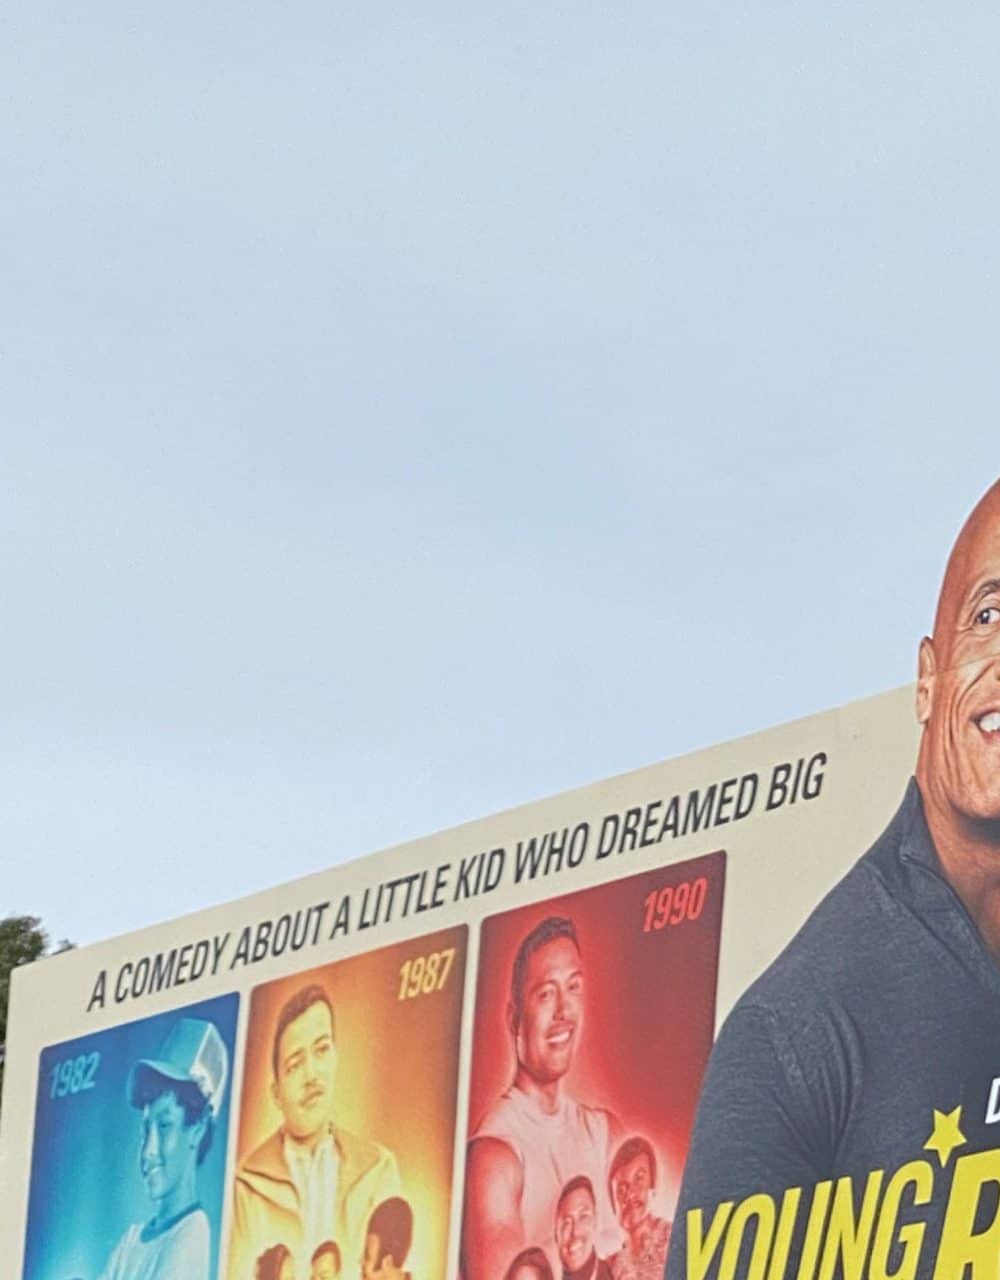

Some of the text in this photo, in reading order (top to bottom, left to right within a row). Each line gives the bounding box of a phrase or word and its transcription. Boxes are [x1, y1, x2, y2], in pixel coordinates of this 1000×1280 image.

[86, 752, 827, 1012] A COMEDY ABOUT A LITTLE KID WHO DREAMED BIG
[643, 877, 707, 934] 1990
[398, 948, 456, 1001] 1987
[50, 1051, 99, 1099] 1982
